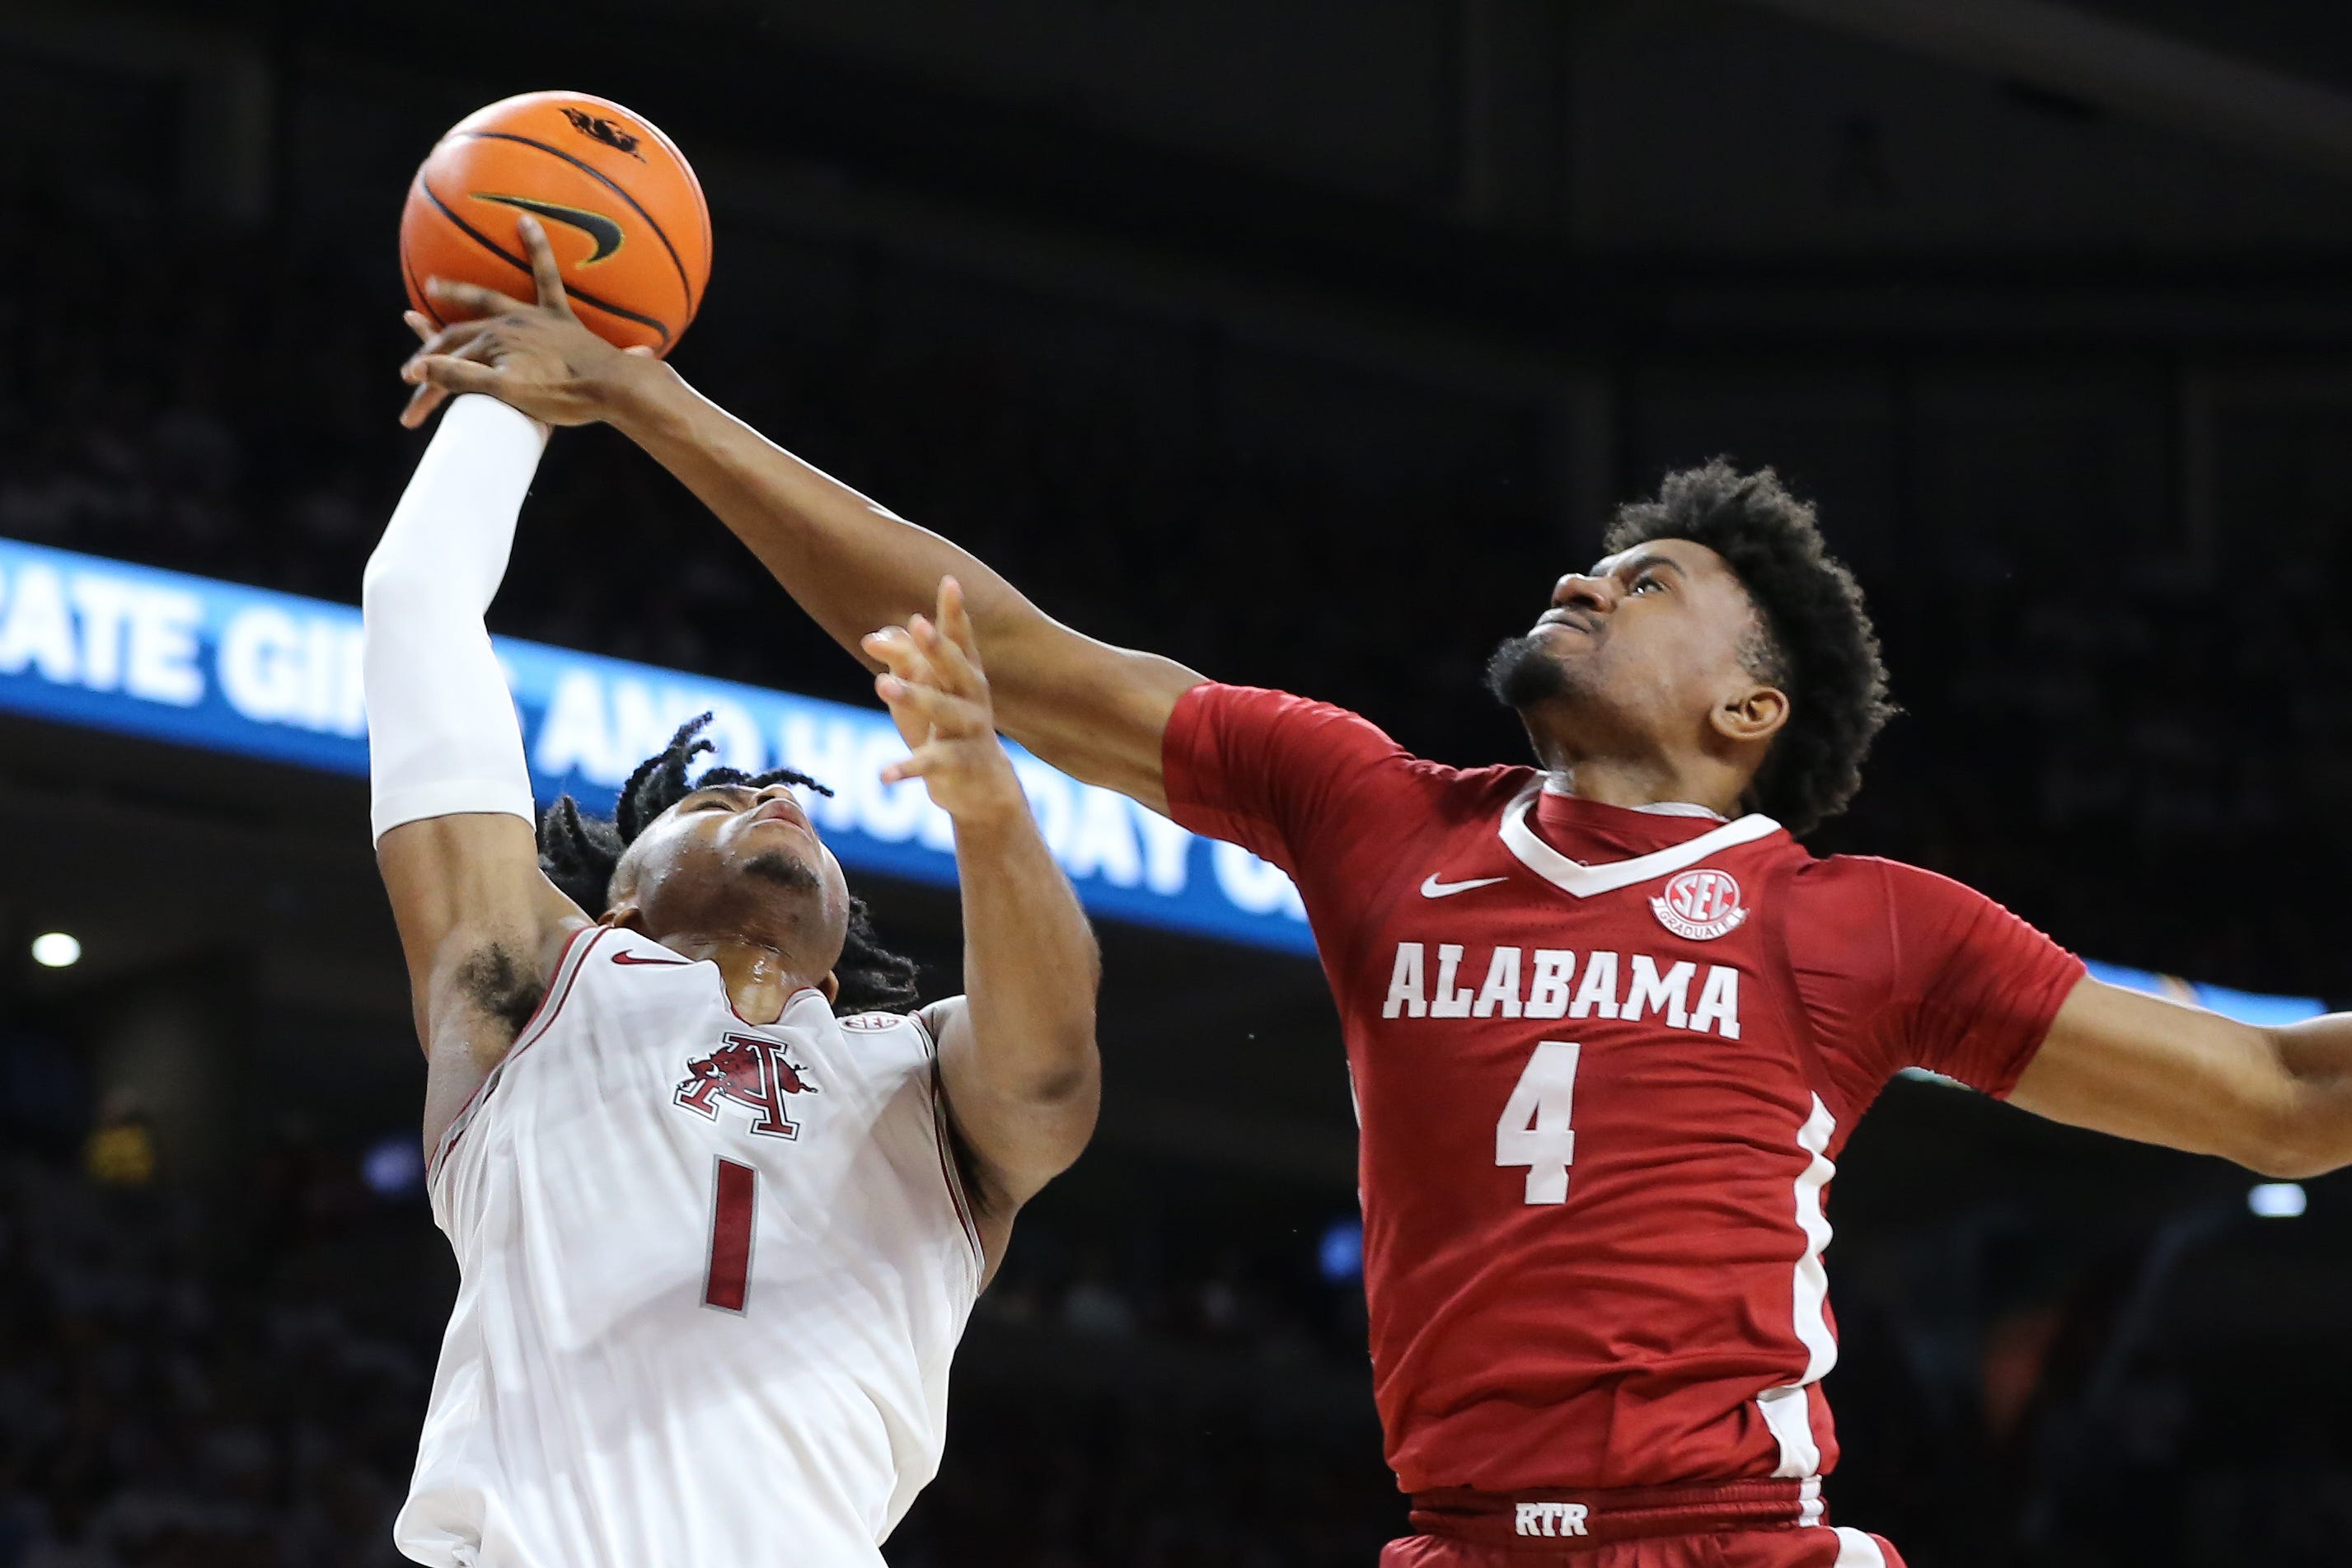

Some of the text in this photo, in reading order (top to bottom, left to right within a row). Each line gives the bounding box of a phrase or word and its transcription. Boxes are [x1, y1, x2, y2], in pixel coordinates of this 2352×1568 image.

[0, 562, 204, 708] ATE
[1670, 874, 1733, 920] SEC
[1382, 942, 1741, 1040] ALABAMA
[1495, 1041, 1581, 1205] 4
[700, 1154, 761, 1318] 1
[1515, 1502, 1589, 1538] RTR
